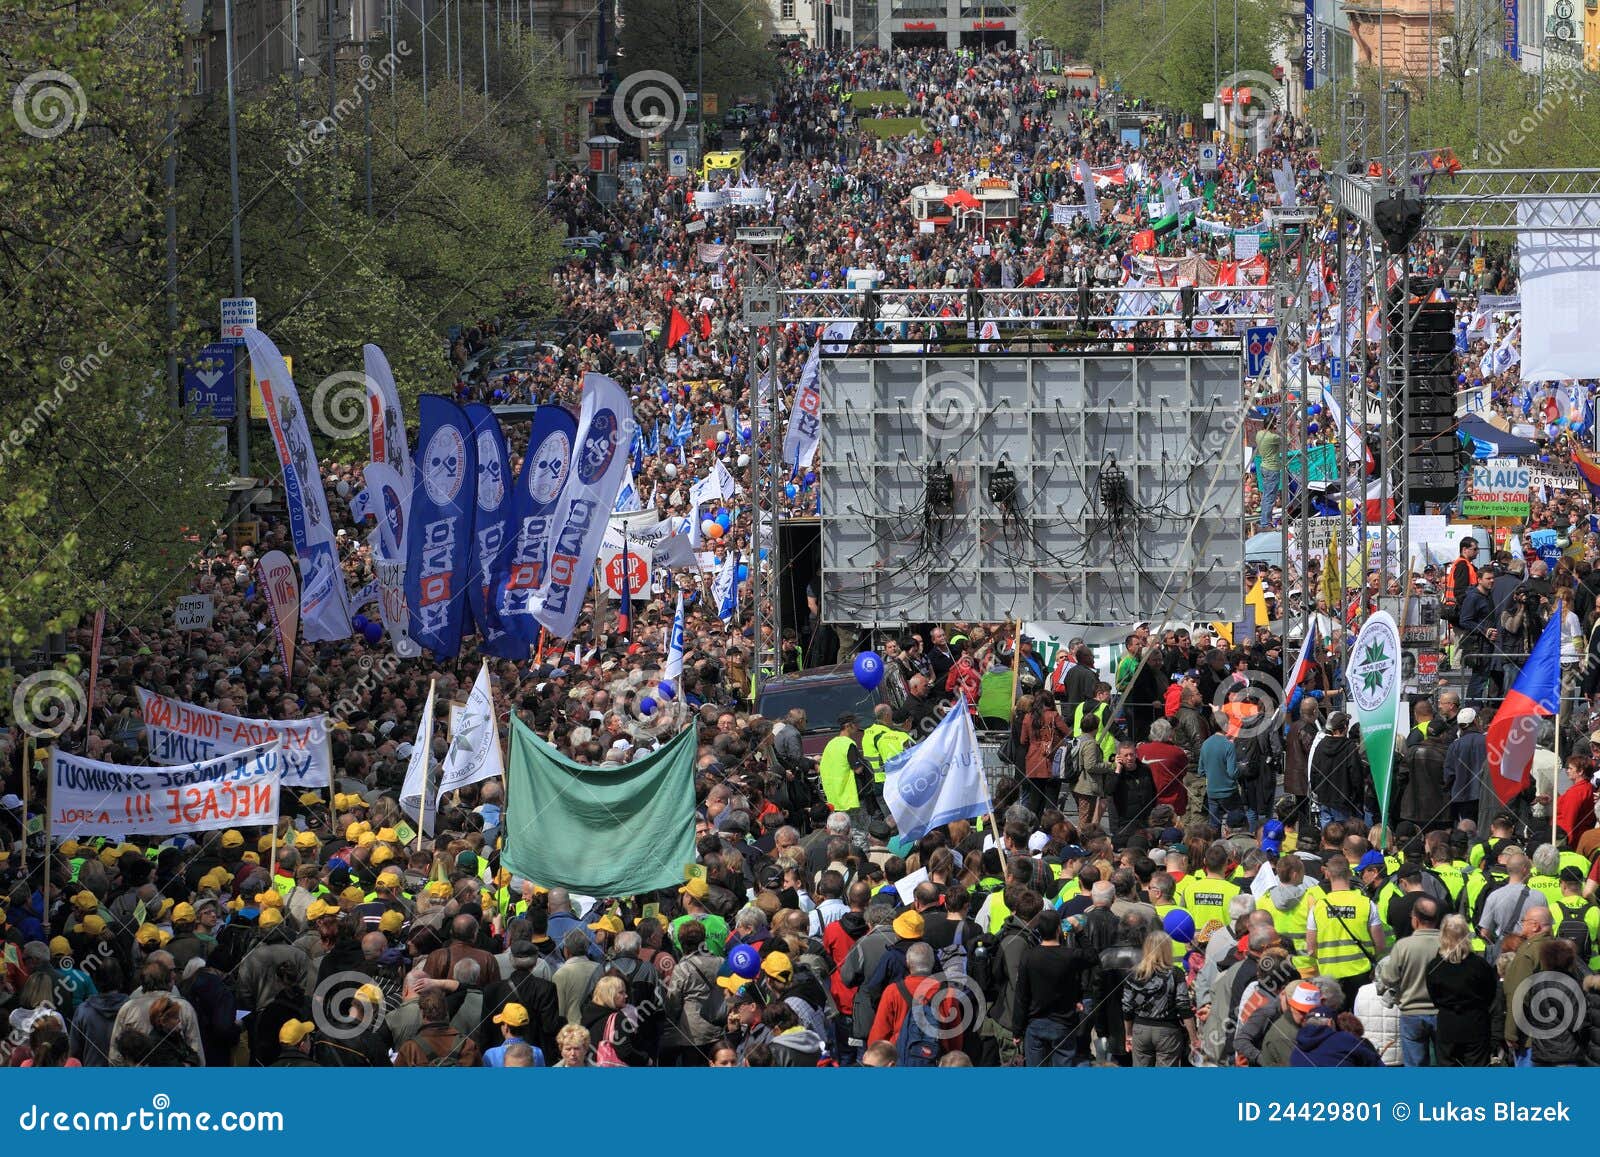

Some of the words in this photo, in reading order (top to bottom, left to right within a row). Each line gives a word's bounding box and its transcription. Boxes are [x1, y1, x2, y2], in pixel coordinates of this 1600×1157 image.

[1306, 13, 1314, 49] GRAAF
[1306, 50, 1314, 71] VAN
[222, 300, 254, 308] prostor
[223, 309, 236, 317] pro
[223, 317, 254, 325] reklamu
[1494, 459, 1511, 468] ANO
[1473, 469, 1530, 489] KLAUS
[180, 601, 204, 611] DEMISI
[180, 613, 205, 625] VLÁDY
